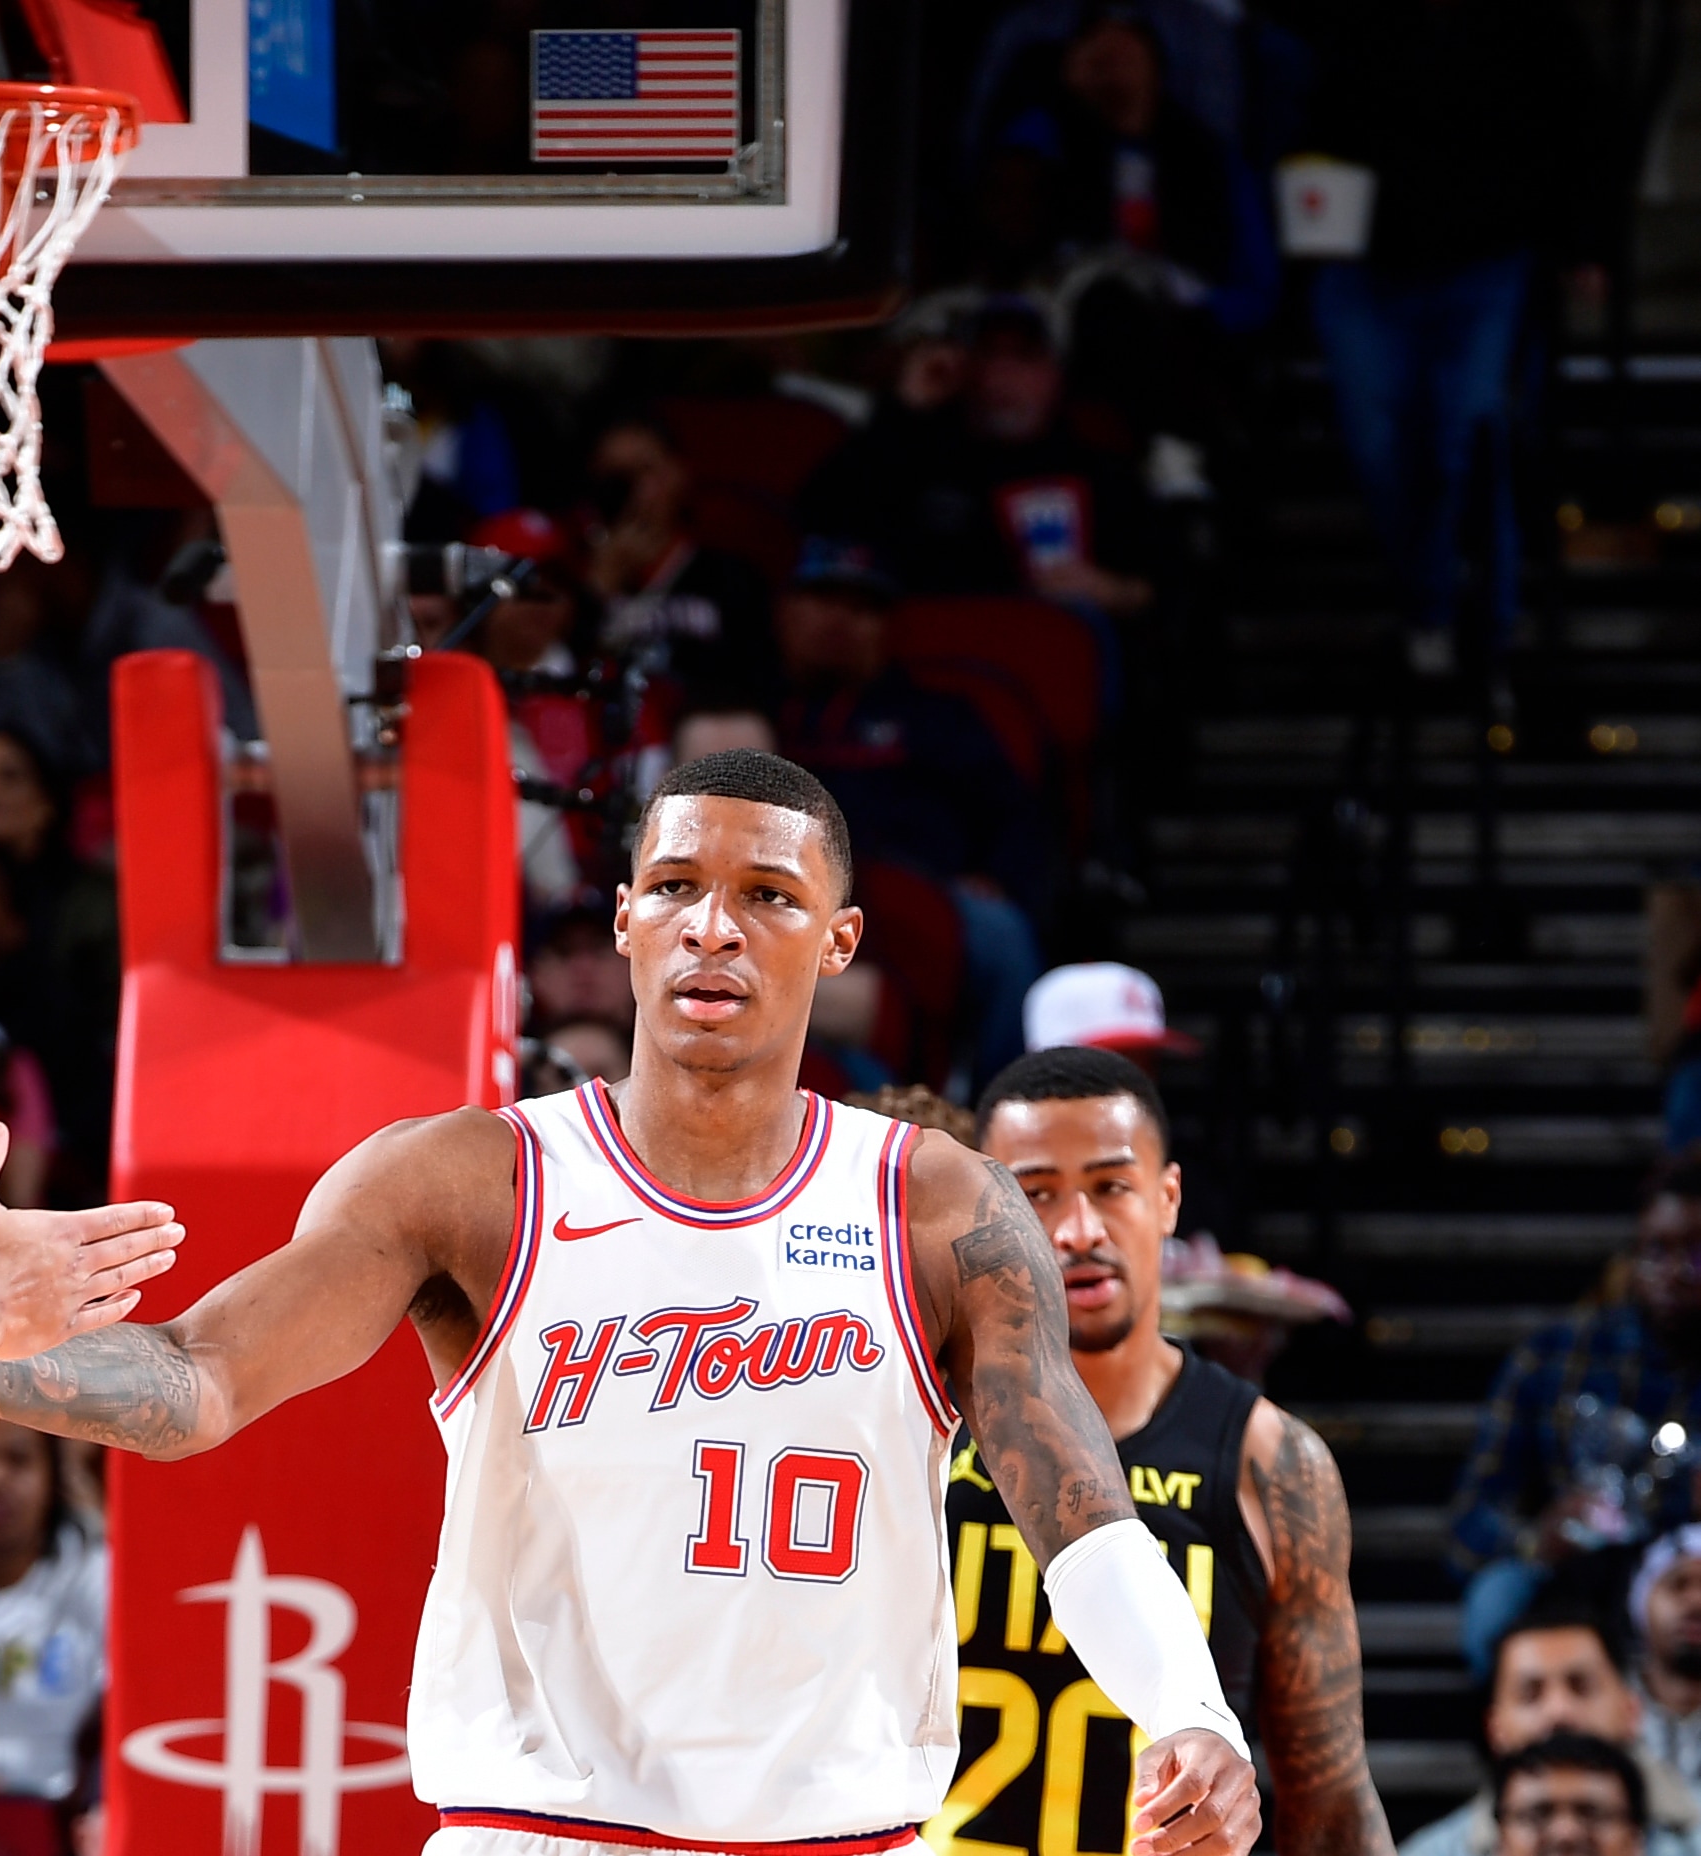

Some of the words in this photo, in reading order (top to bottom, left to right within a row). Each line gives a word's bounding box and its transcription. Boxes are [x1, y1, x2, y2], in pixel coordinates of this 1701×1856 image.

[785, 1241, 876, 1272] karma
[789, 1222, 875, 1247] credit
[522, 1295, 885, 1435] H-Town
[684, 1439, 870, 1585] 10
